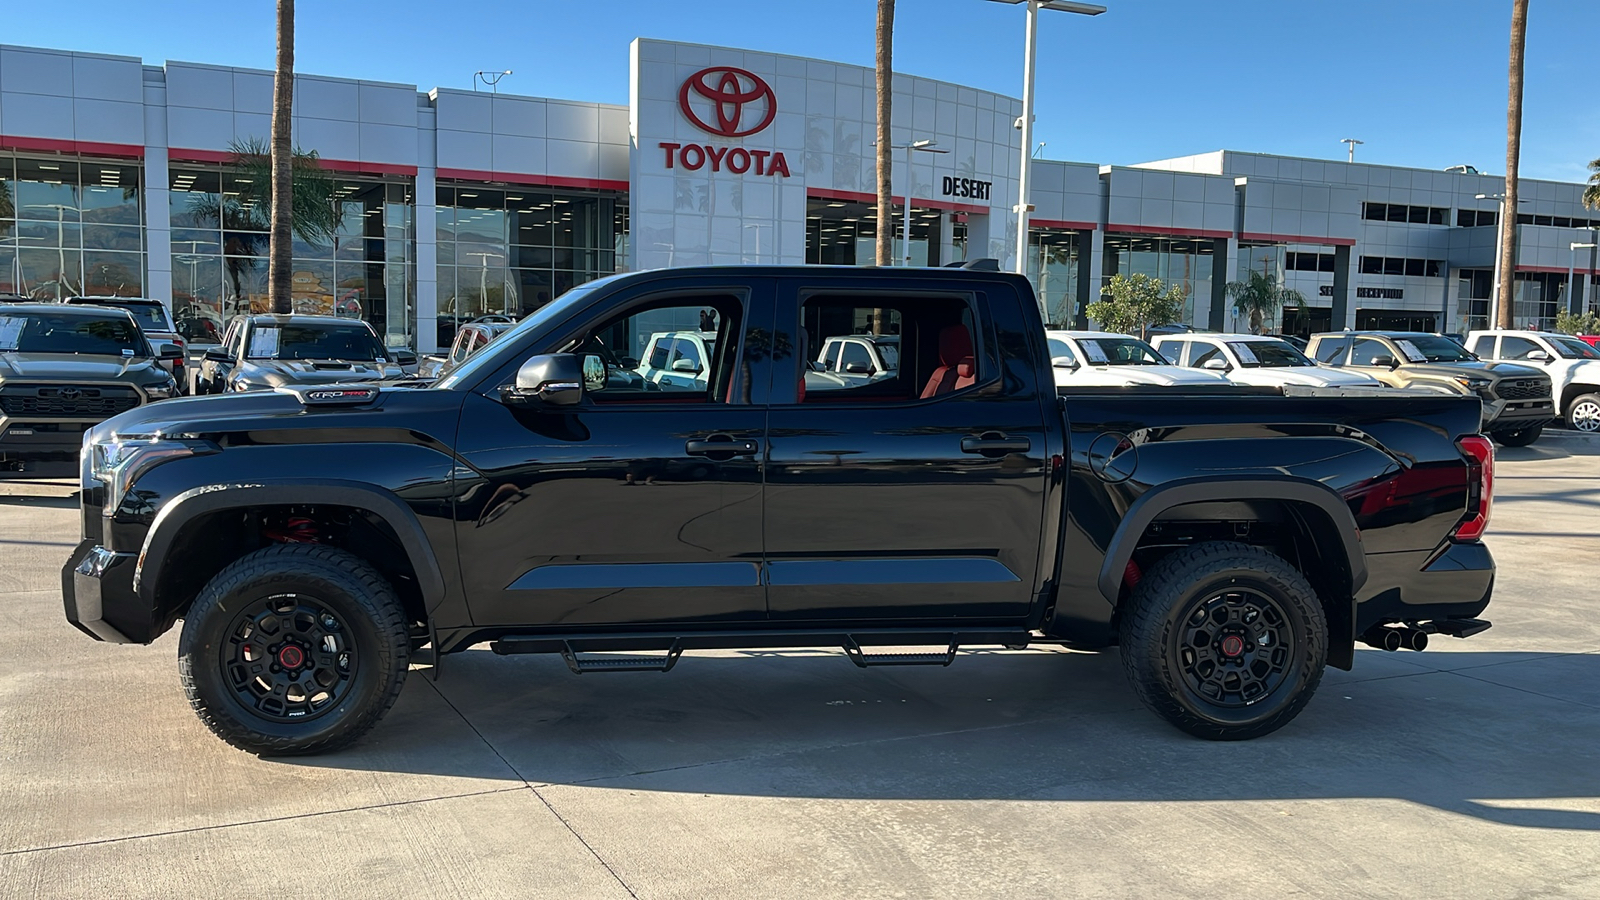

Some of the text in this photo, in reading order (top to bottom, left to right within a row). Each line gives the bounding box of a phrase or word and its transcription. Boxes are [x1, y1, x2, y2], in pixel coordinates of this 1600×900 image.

[658, 142, 790, 178] TOYOTA
[943, 176, 992, 200] DESERT
[1357, 287, 1404, 299] RECEPTION
